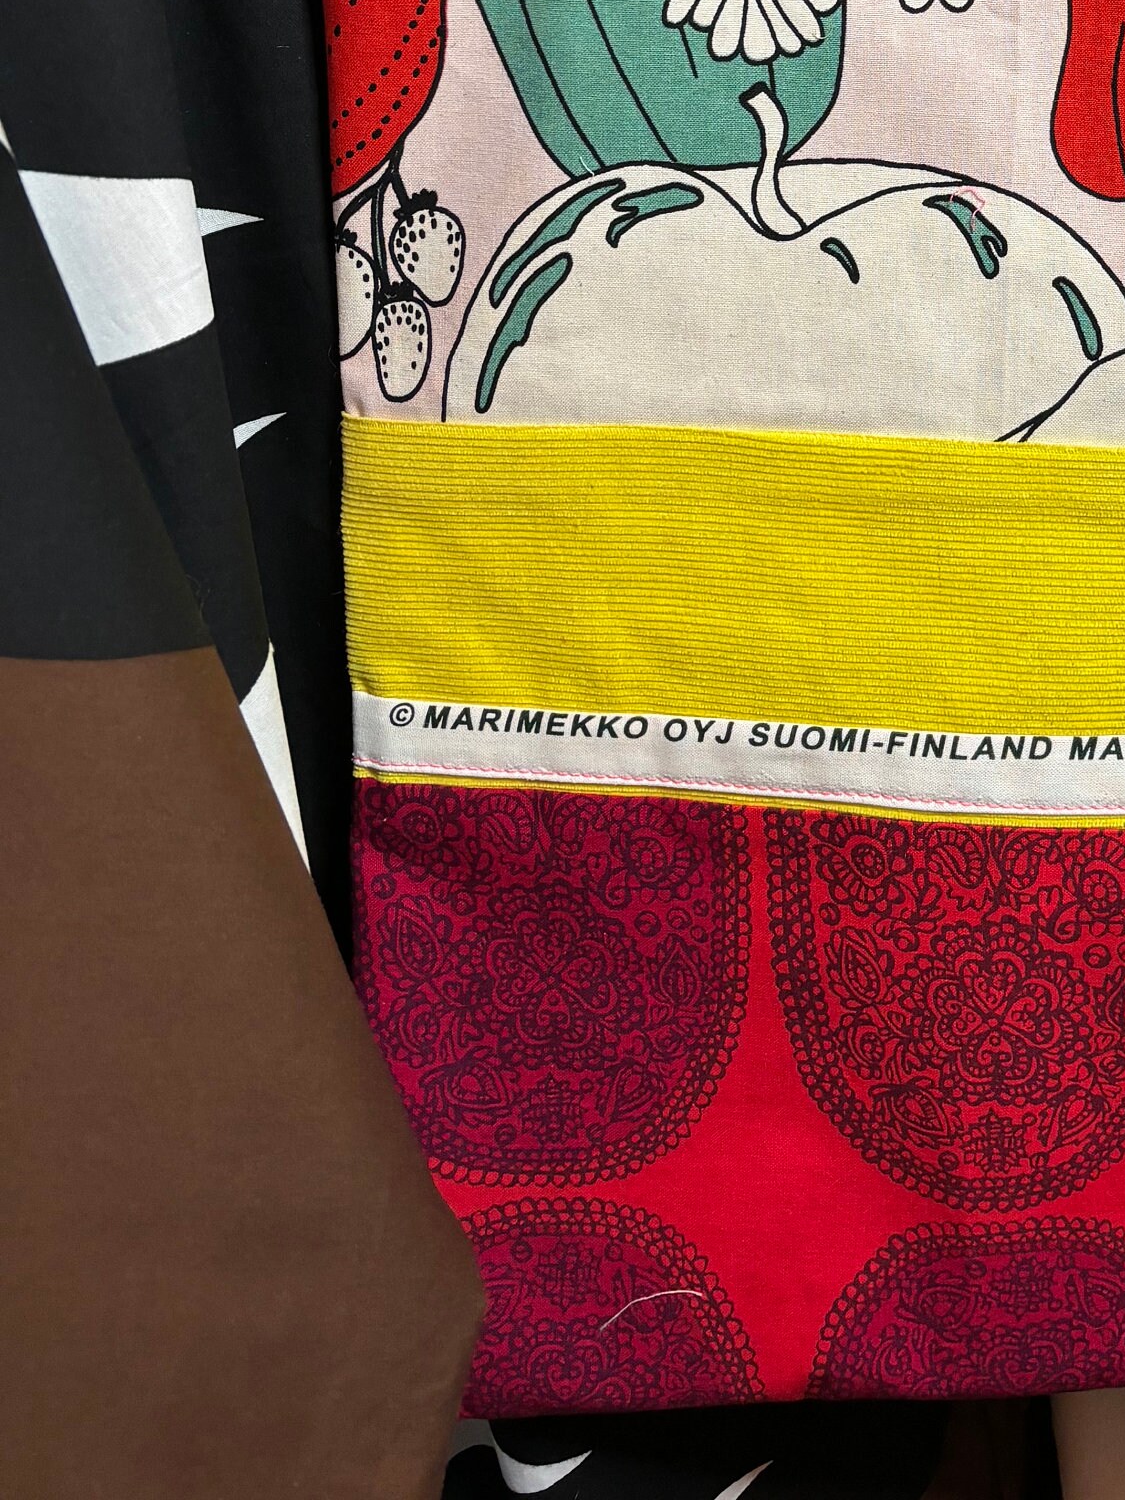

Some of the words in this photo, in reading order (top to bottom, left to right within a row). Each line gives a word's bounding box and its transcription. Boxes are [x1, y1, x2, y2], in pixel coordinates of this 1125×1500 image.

[422, 705, 649, 739] MARIMEKKO
[663, 718, 735, 745] OYJ
[748, 722, 1052, 761] SUOMI-FINLAND
